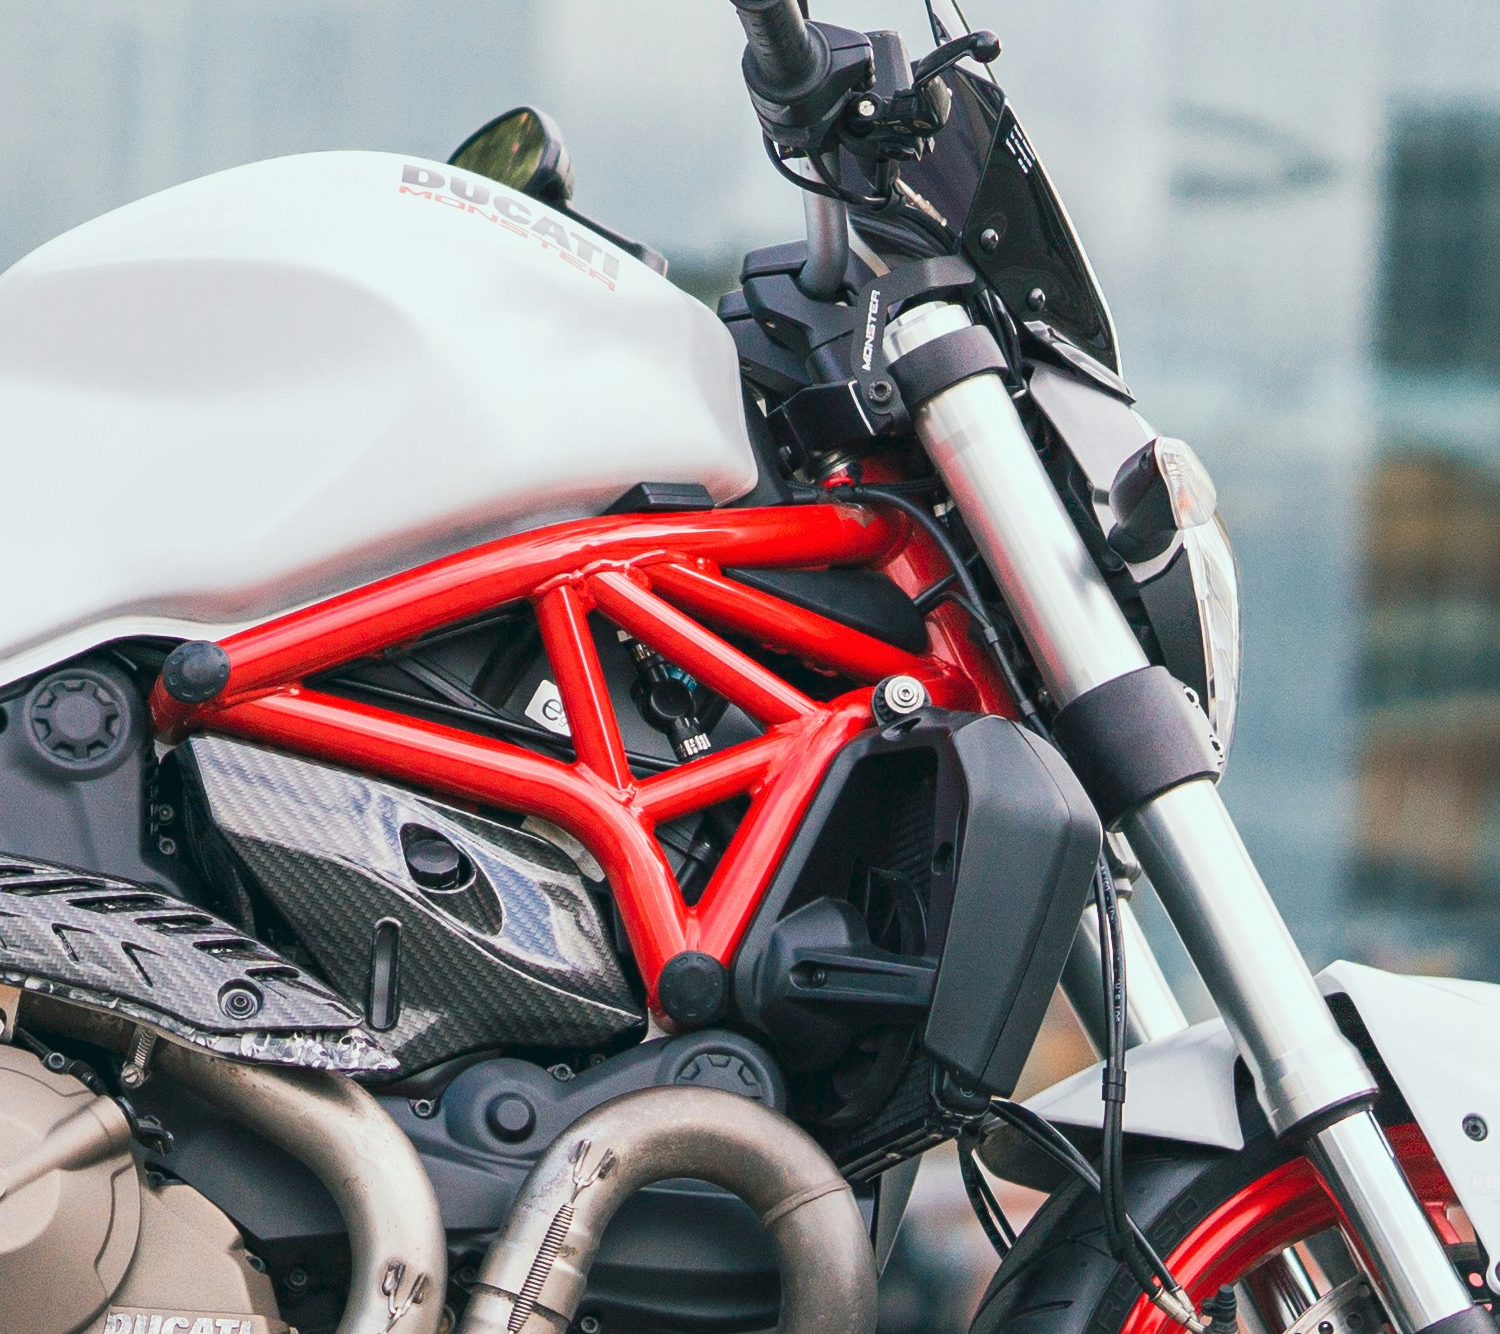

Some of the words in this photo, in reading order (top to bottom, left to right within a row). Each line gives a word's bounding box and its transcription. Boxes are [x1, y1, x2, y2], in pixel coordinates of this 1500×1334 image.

[398, 185, 616, 292] MONSTER
[401, 163, 620, 281] DUCATI
[861, 289, 881, 372] MONSTER
